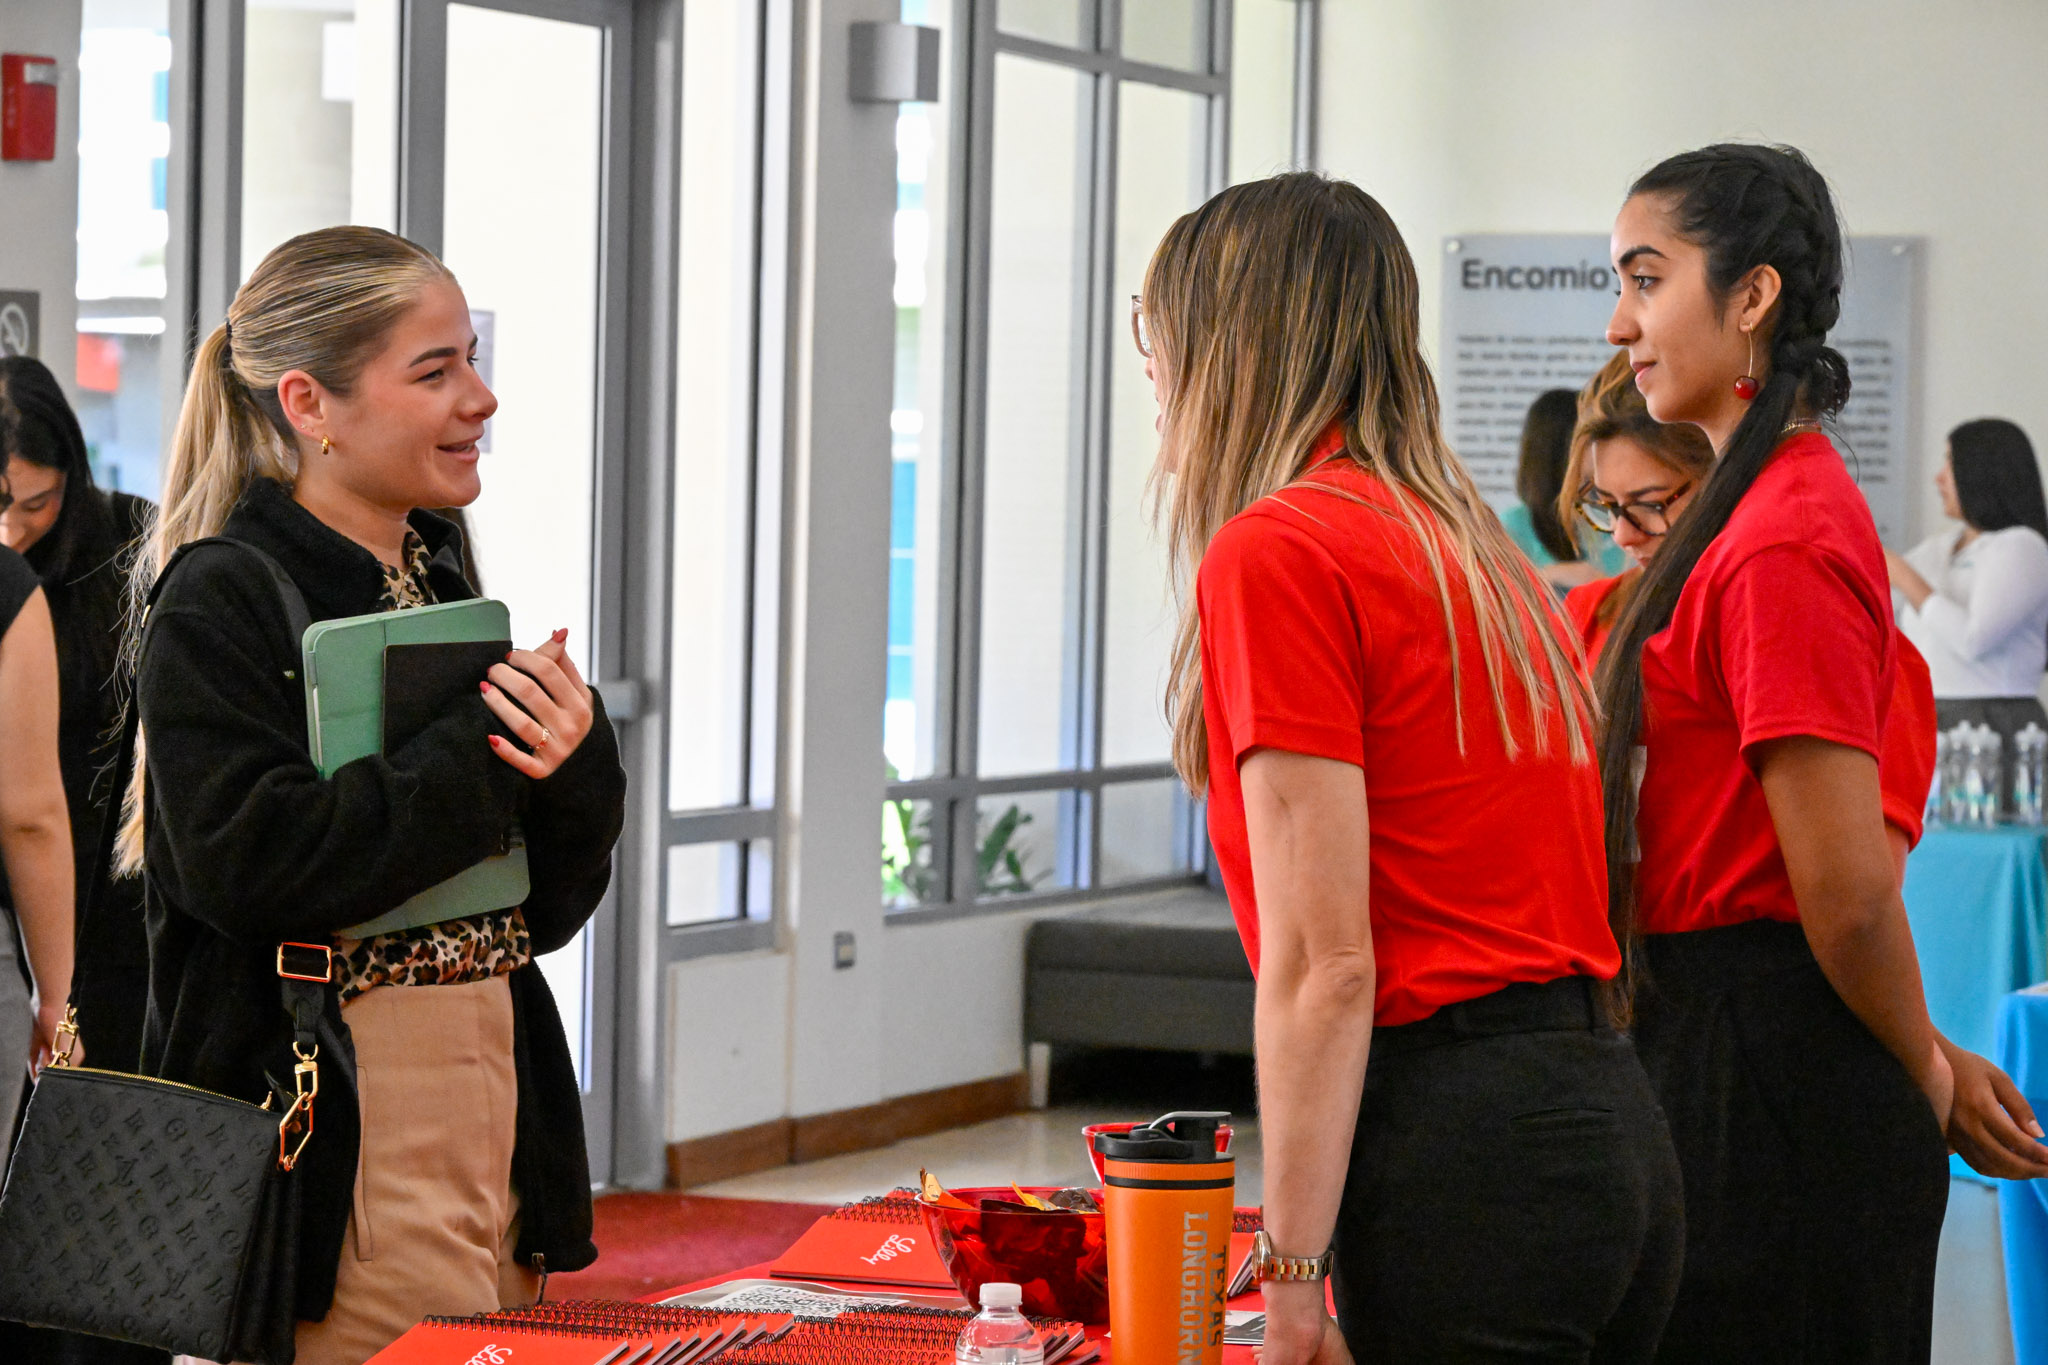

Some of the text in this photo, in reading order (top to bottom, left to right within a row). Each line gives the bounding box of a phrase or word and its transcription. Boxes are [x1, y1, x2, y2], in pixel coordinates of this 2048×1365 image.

[1462, 258, 1609, 290] Encomio
[860, 1234, 916, 1265] Lilly
[1178, 1211, 1209, 1365] LONGHORN
[1206, 1244, 1227, 1347] TEXAS
